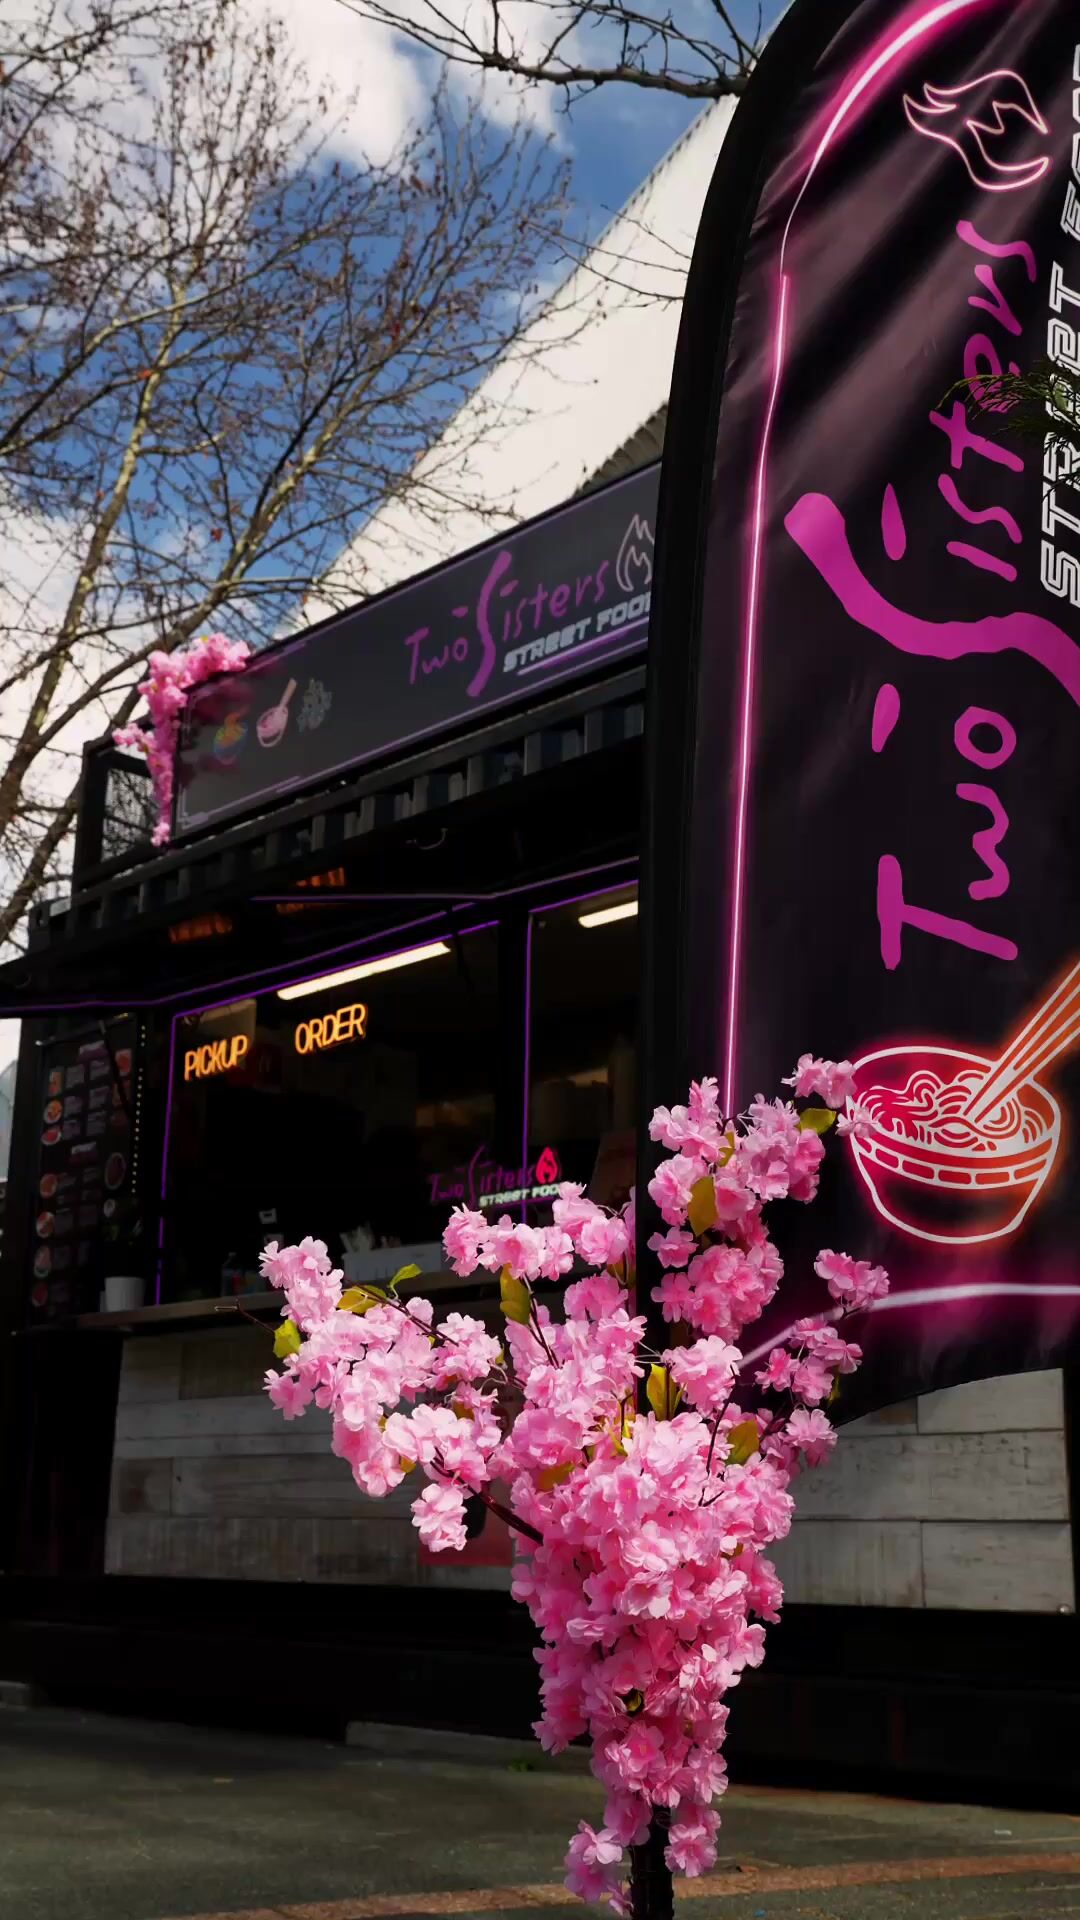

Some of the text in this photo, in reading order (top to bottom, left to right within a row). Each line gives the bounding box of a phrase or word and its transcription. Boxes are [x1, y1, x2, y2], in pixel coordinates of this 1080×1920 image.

[404, 551, 609, 697] Two Sisters
[503, 616, 592, 673] STREET
[876, 706, 1019, 971] Two
[294, 1003, 367, 1055] ORDER
[184, 1034, 249, 1081] PICKUP
[531, 1183, 561, 1200] FOO
